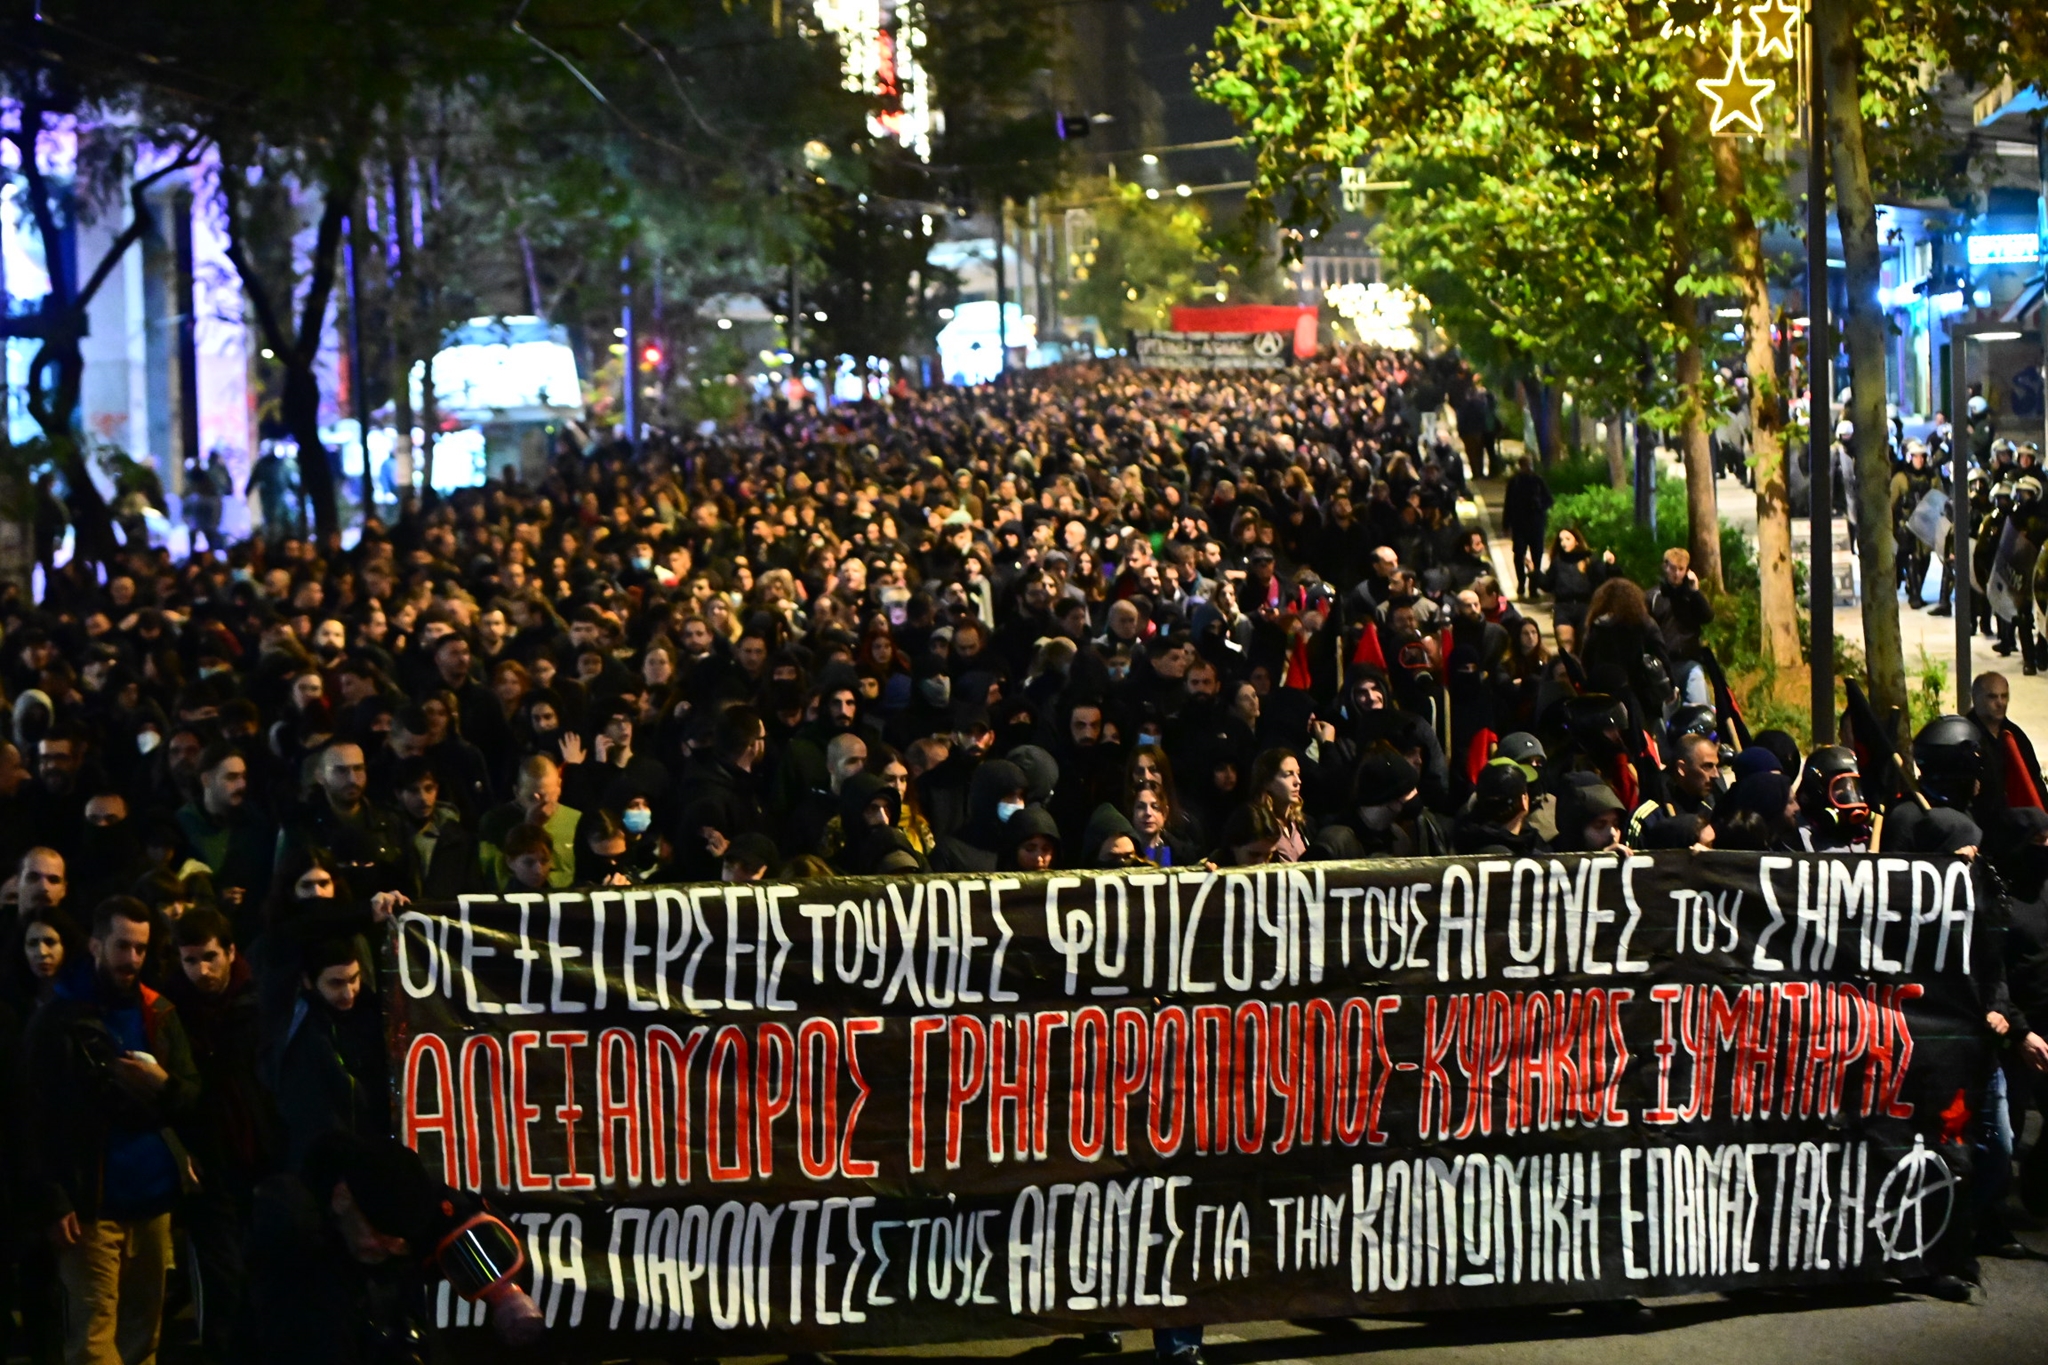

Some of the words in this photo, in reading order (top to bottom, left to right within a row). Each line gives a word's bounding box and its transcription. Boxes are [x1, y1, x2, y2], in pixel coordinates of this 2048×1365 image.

[883, 878, 1019, 1009] ΧΘΕΣ
[1437, 857, 1656, 981] ΑΓΩΝΕΣ
[1752, 857, 1976, 976] ΣΗΜΕΡΑ
[1008, 1175, 1193, 1315] ΑΓΩΝΕΣ
[1351, 1152, 1602, 1294] ΚΟΙΝΩΝΙΚΗ
[1621, 1141, 1868, 1281] ΕΠΑΝΑΣΤΑΣΗ
